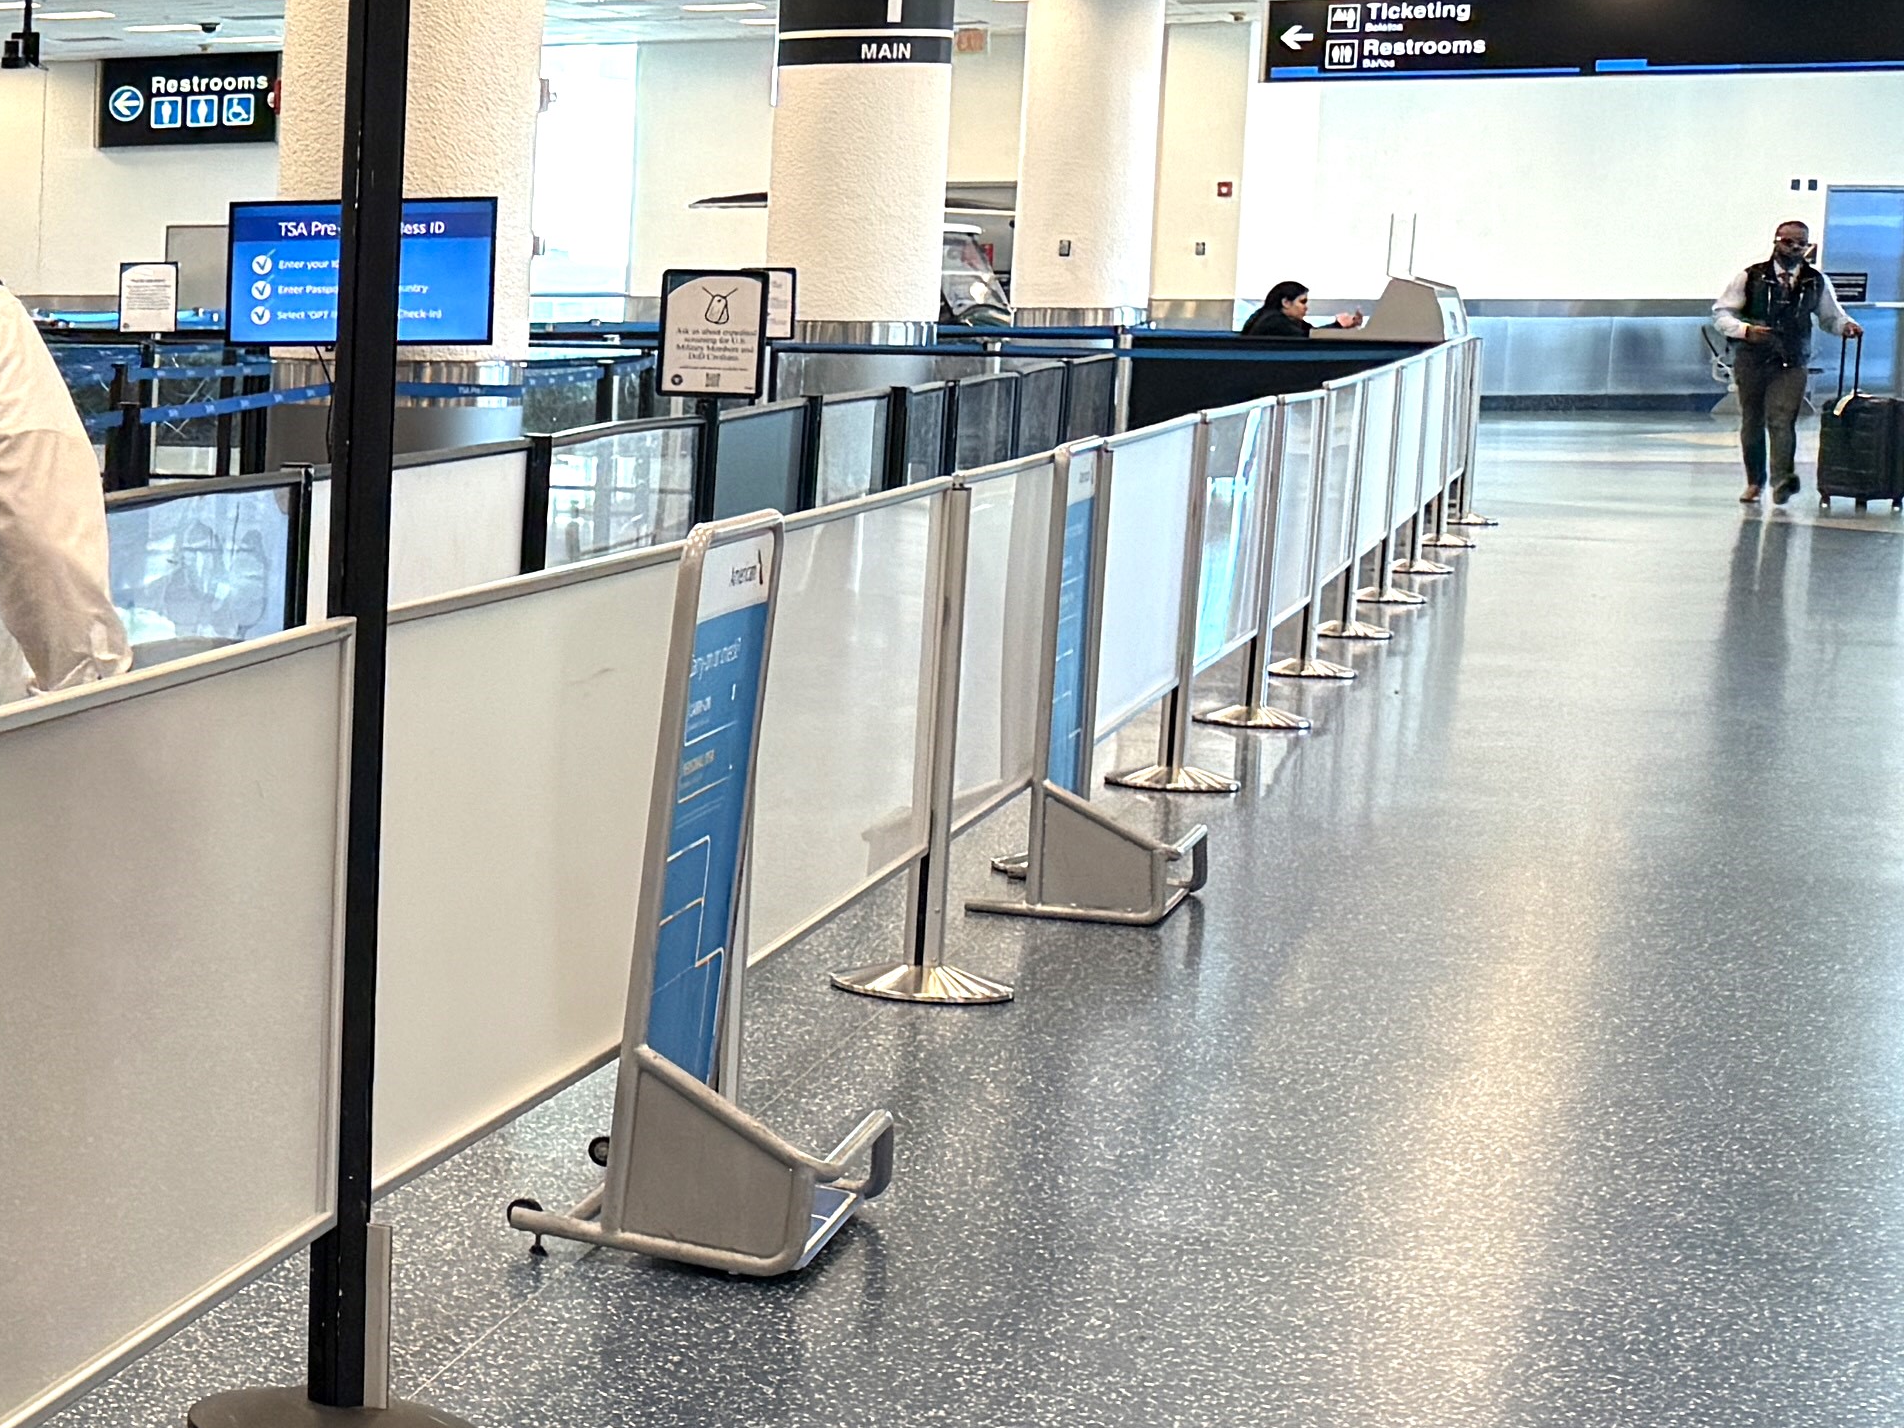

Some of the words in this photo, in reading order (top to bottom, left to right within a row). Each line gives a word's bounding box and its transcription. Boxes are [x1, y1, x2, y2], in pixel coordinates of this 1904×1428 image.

[1366, 2, 1471, 21] Ticketing
[861, 43, 911, 60] MAIN
[1363, 38, 1486, 56] Restrooms
[151, 75, 268, 94] Restrooms
[278, 222, 308, 236] TSA
[311, 221, 337, 236] Pre
[430, 221, 445, 234] ID
[729, 562, 757, 588] American
